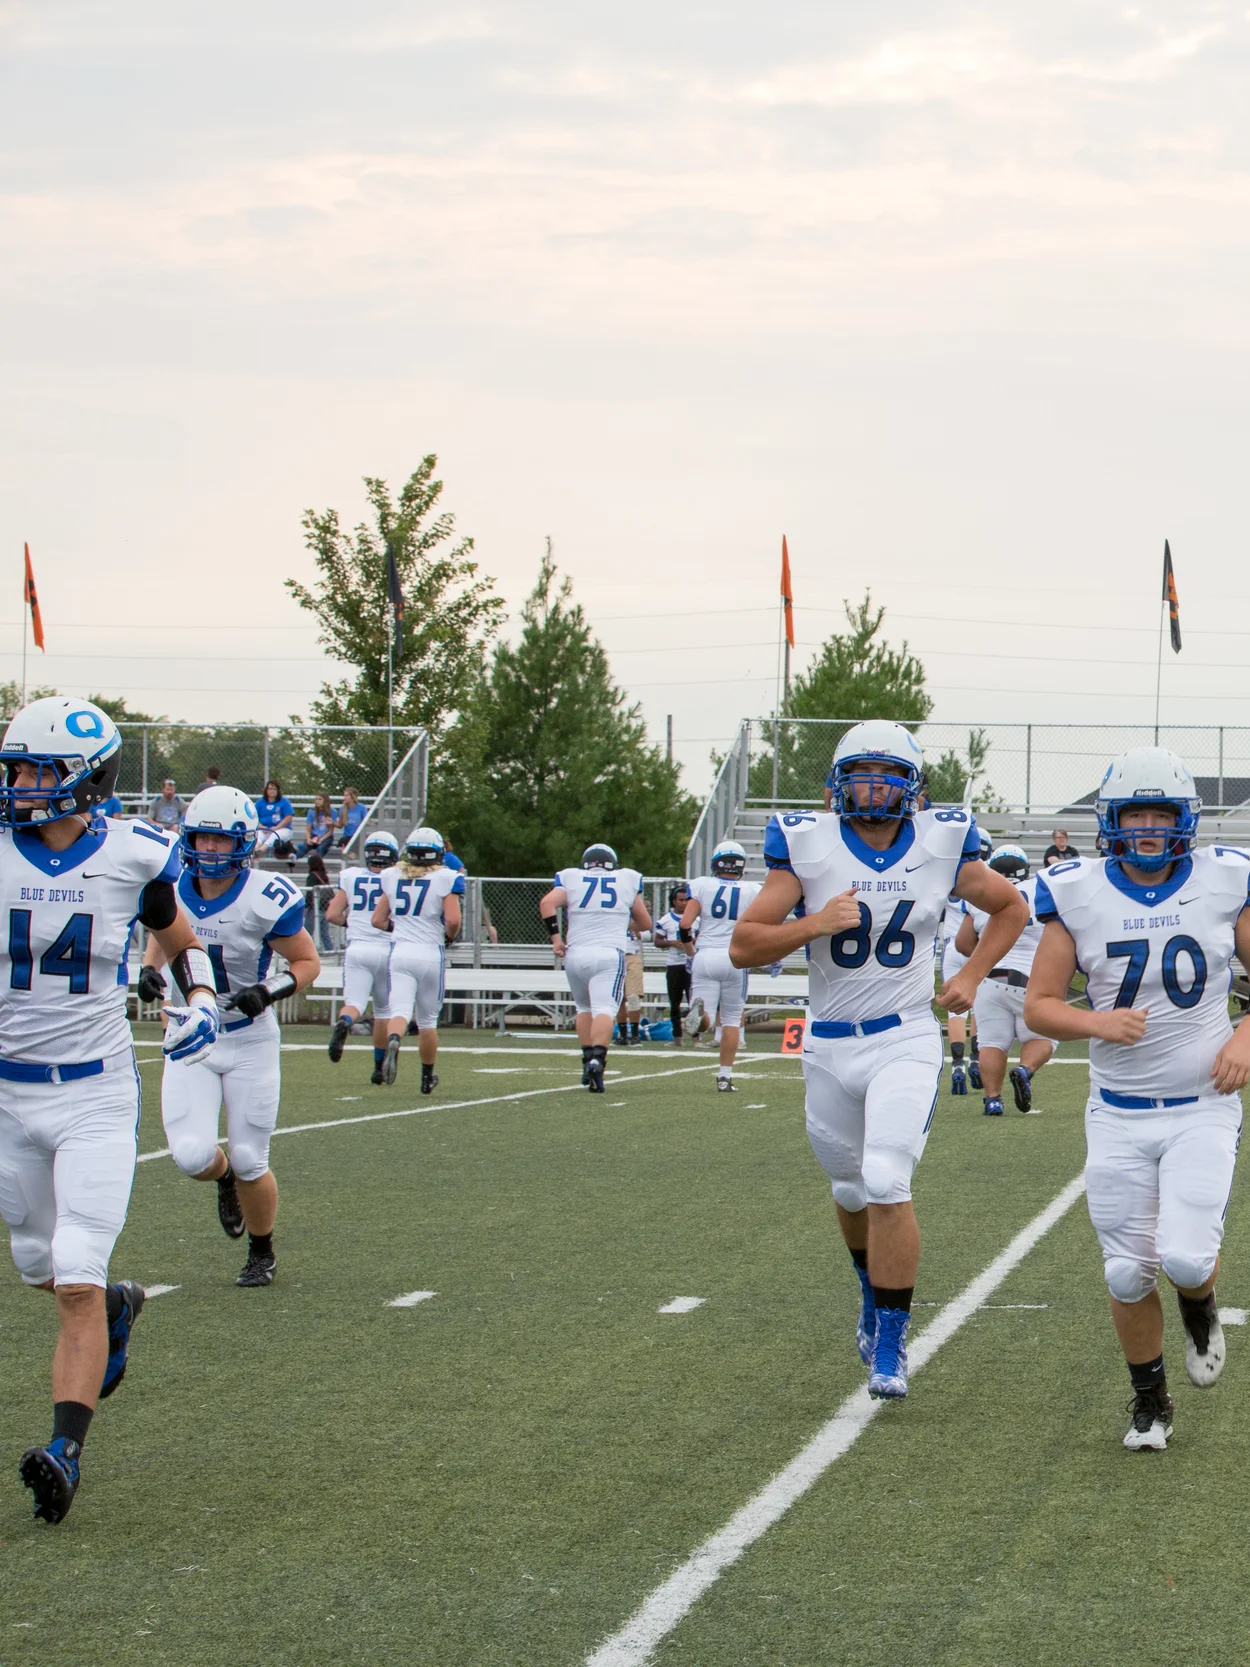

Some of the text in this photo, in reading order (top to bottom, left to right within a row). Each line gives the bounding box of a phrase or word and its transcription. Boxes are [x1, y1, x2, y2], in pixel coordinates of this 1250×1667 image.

[65, 710, 106, 739] Q
[1136, 789, 1163, 797] Riddell
[20, 887, 84, 903] BLUE DEVILS
[262, 876, 297, 908] 51
[353, 877, 383, 911] 52
[395, 879, 431, 916] 57
[579, 877, 617, 908] 75
[852, 881, 907, 892] BLUE DEVILS
[711, 886, 741, 920] 61
[195, 926, 218, 939] DEVILS
[830, 900, 916, 969] 86
[1123, 914, 1181, 930] BLUE DEVILS
[9, 908, 94, 995] 14
[208, 944, 231, 994] 1
[1106, 934, 1208, 1010] 70
